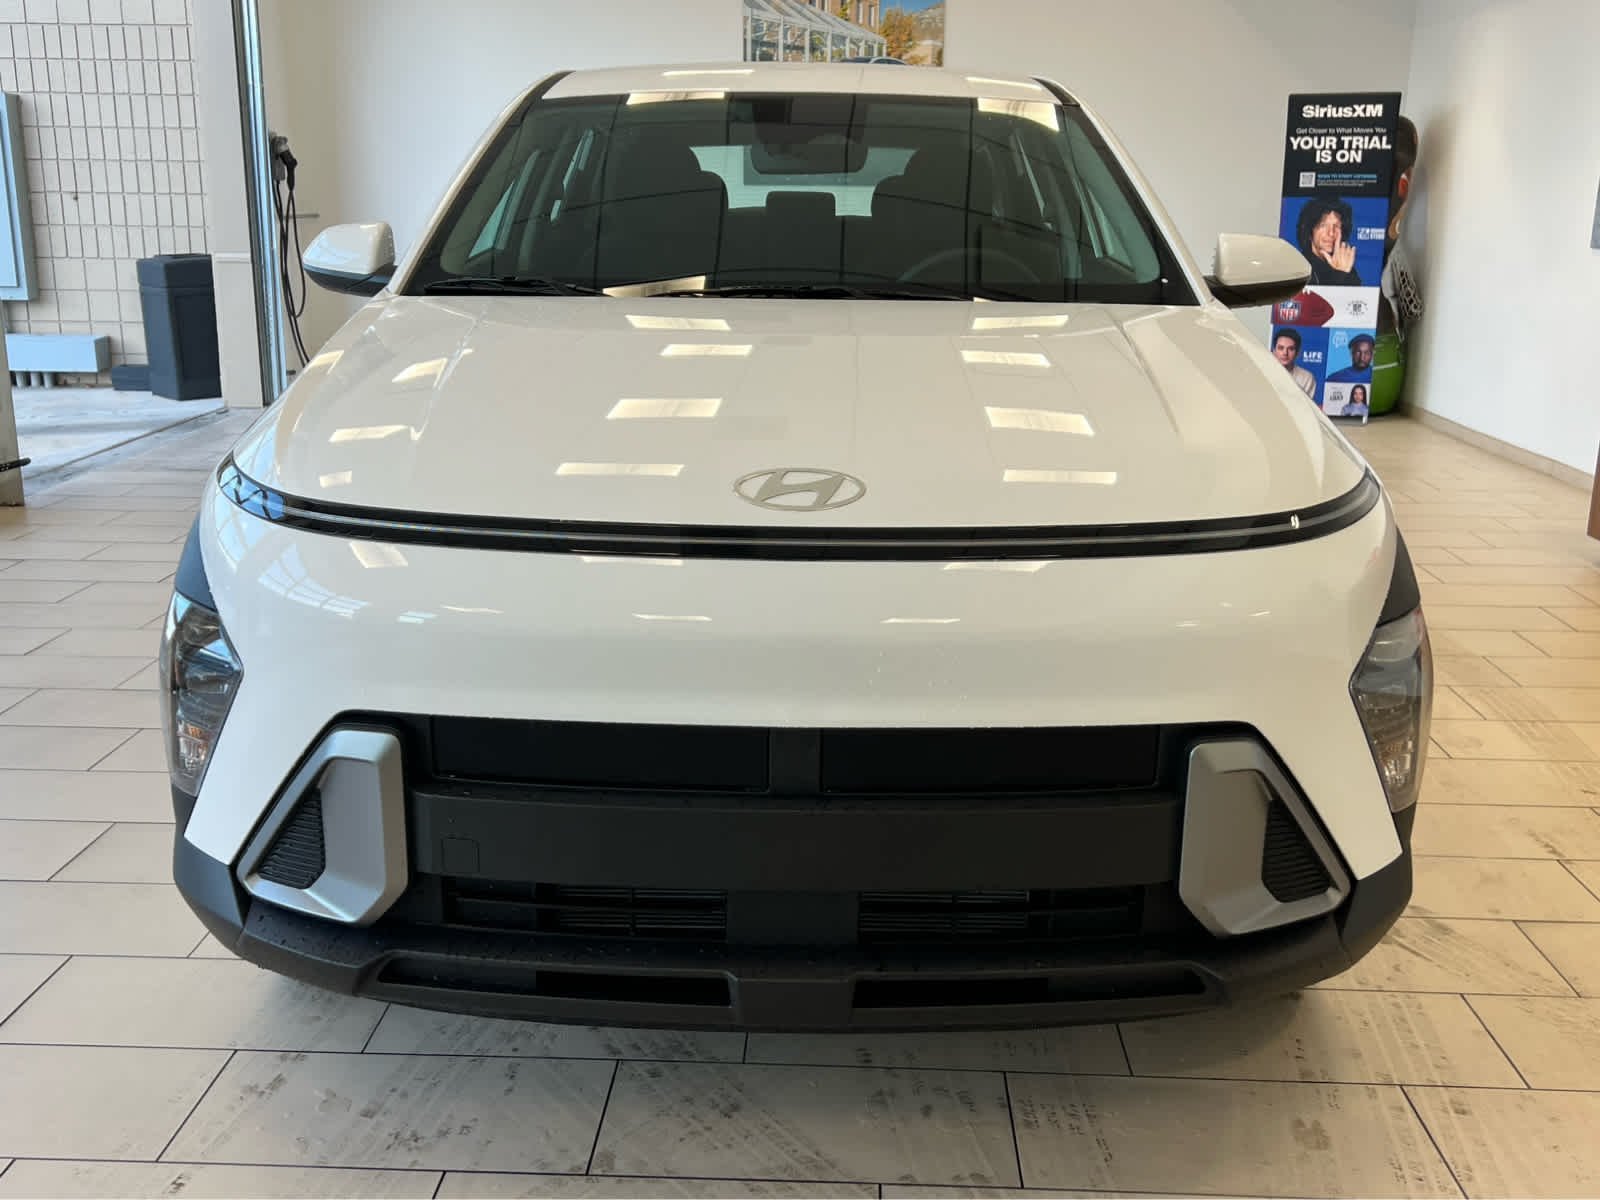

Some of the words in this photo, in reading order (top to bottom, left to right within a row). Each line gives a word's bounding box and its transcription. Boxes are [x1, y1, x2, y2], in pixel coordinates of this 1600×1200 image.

[1302, 104, 1383, 118] SiriusXM
[1290, 136, 1337, 150] YOUR
[1341, 136, 1392, 149] TRIAL
[1316, 150, 1332, 163] IS
[1336, 150, 1362, 163] ON
[1303, 351, 1323, 359] LIFE
